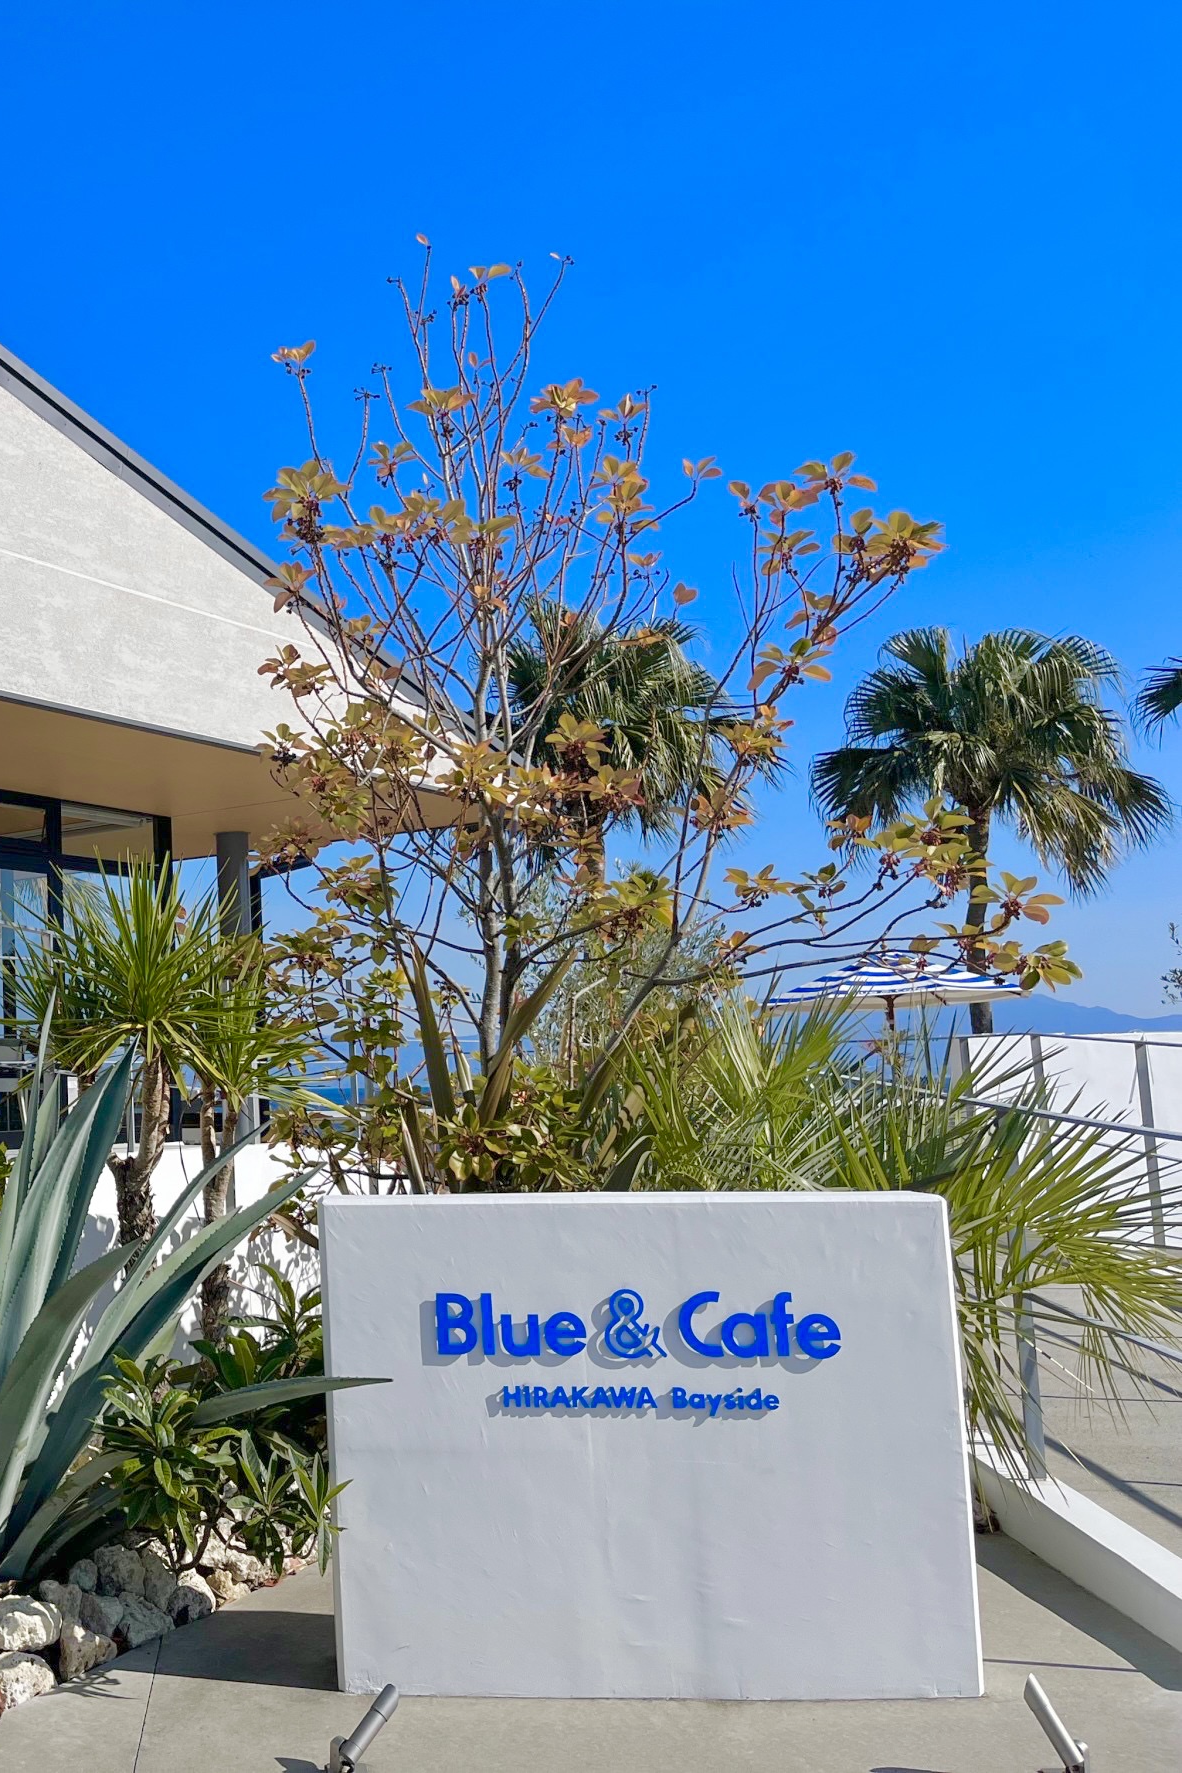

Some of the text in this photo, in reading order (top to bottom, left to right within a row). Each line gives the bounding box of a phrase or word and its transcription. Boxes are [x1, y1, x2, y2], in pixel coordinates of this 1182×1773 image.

[435, 1288, 841, 1360] Blue & Cafe
[502, 1385, 780, 1417] HIRAKAWA Bayside
